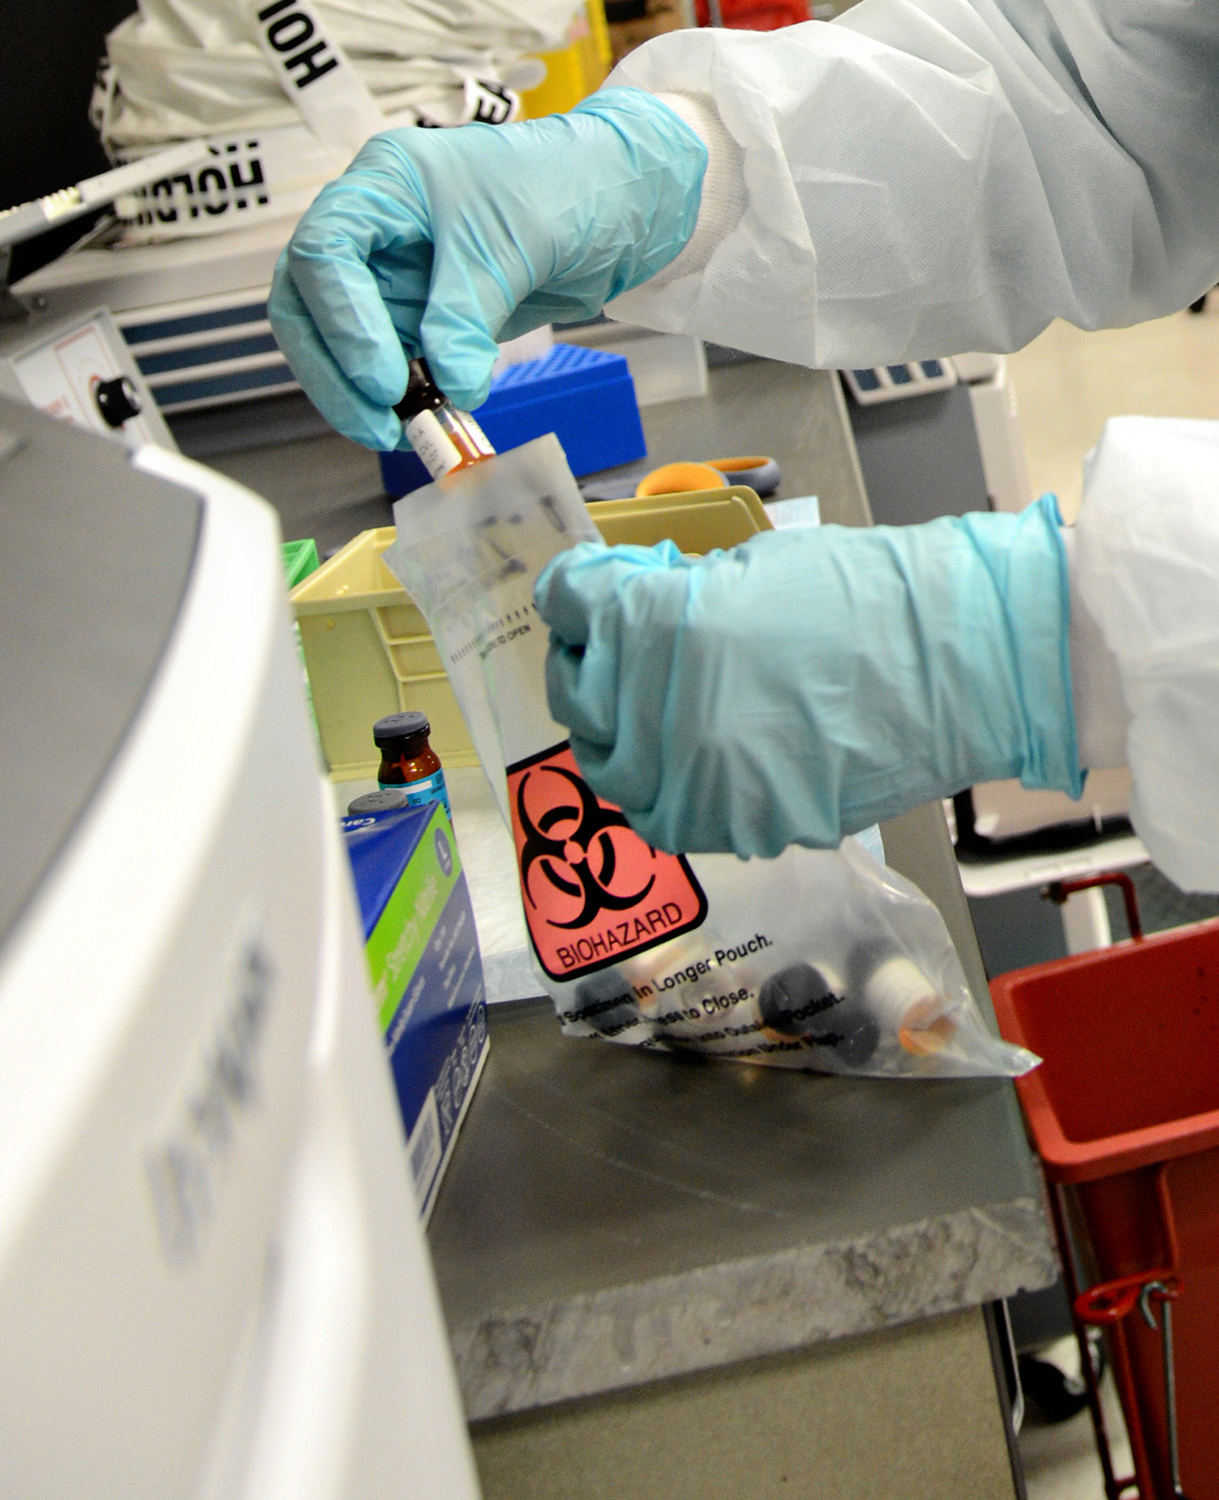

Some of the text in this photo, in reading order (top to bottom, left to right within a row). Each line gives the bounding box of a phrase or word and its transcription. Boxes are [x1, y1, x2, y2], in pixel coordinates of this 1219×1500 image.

[506, 624, 531, 641] OPEN
[556, 902, 683, 969] BIOHAZARD
[651, 956, 712, 992] Longer
[714, 933, 773, 967] Pouch.
[701, 986, 755, 1016] Close.
